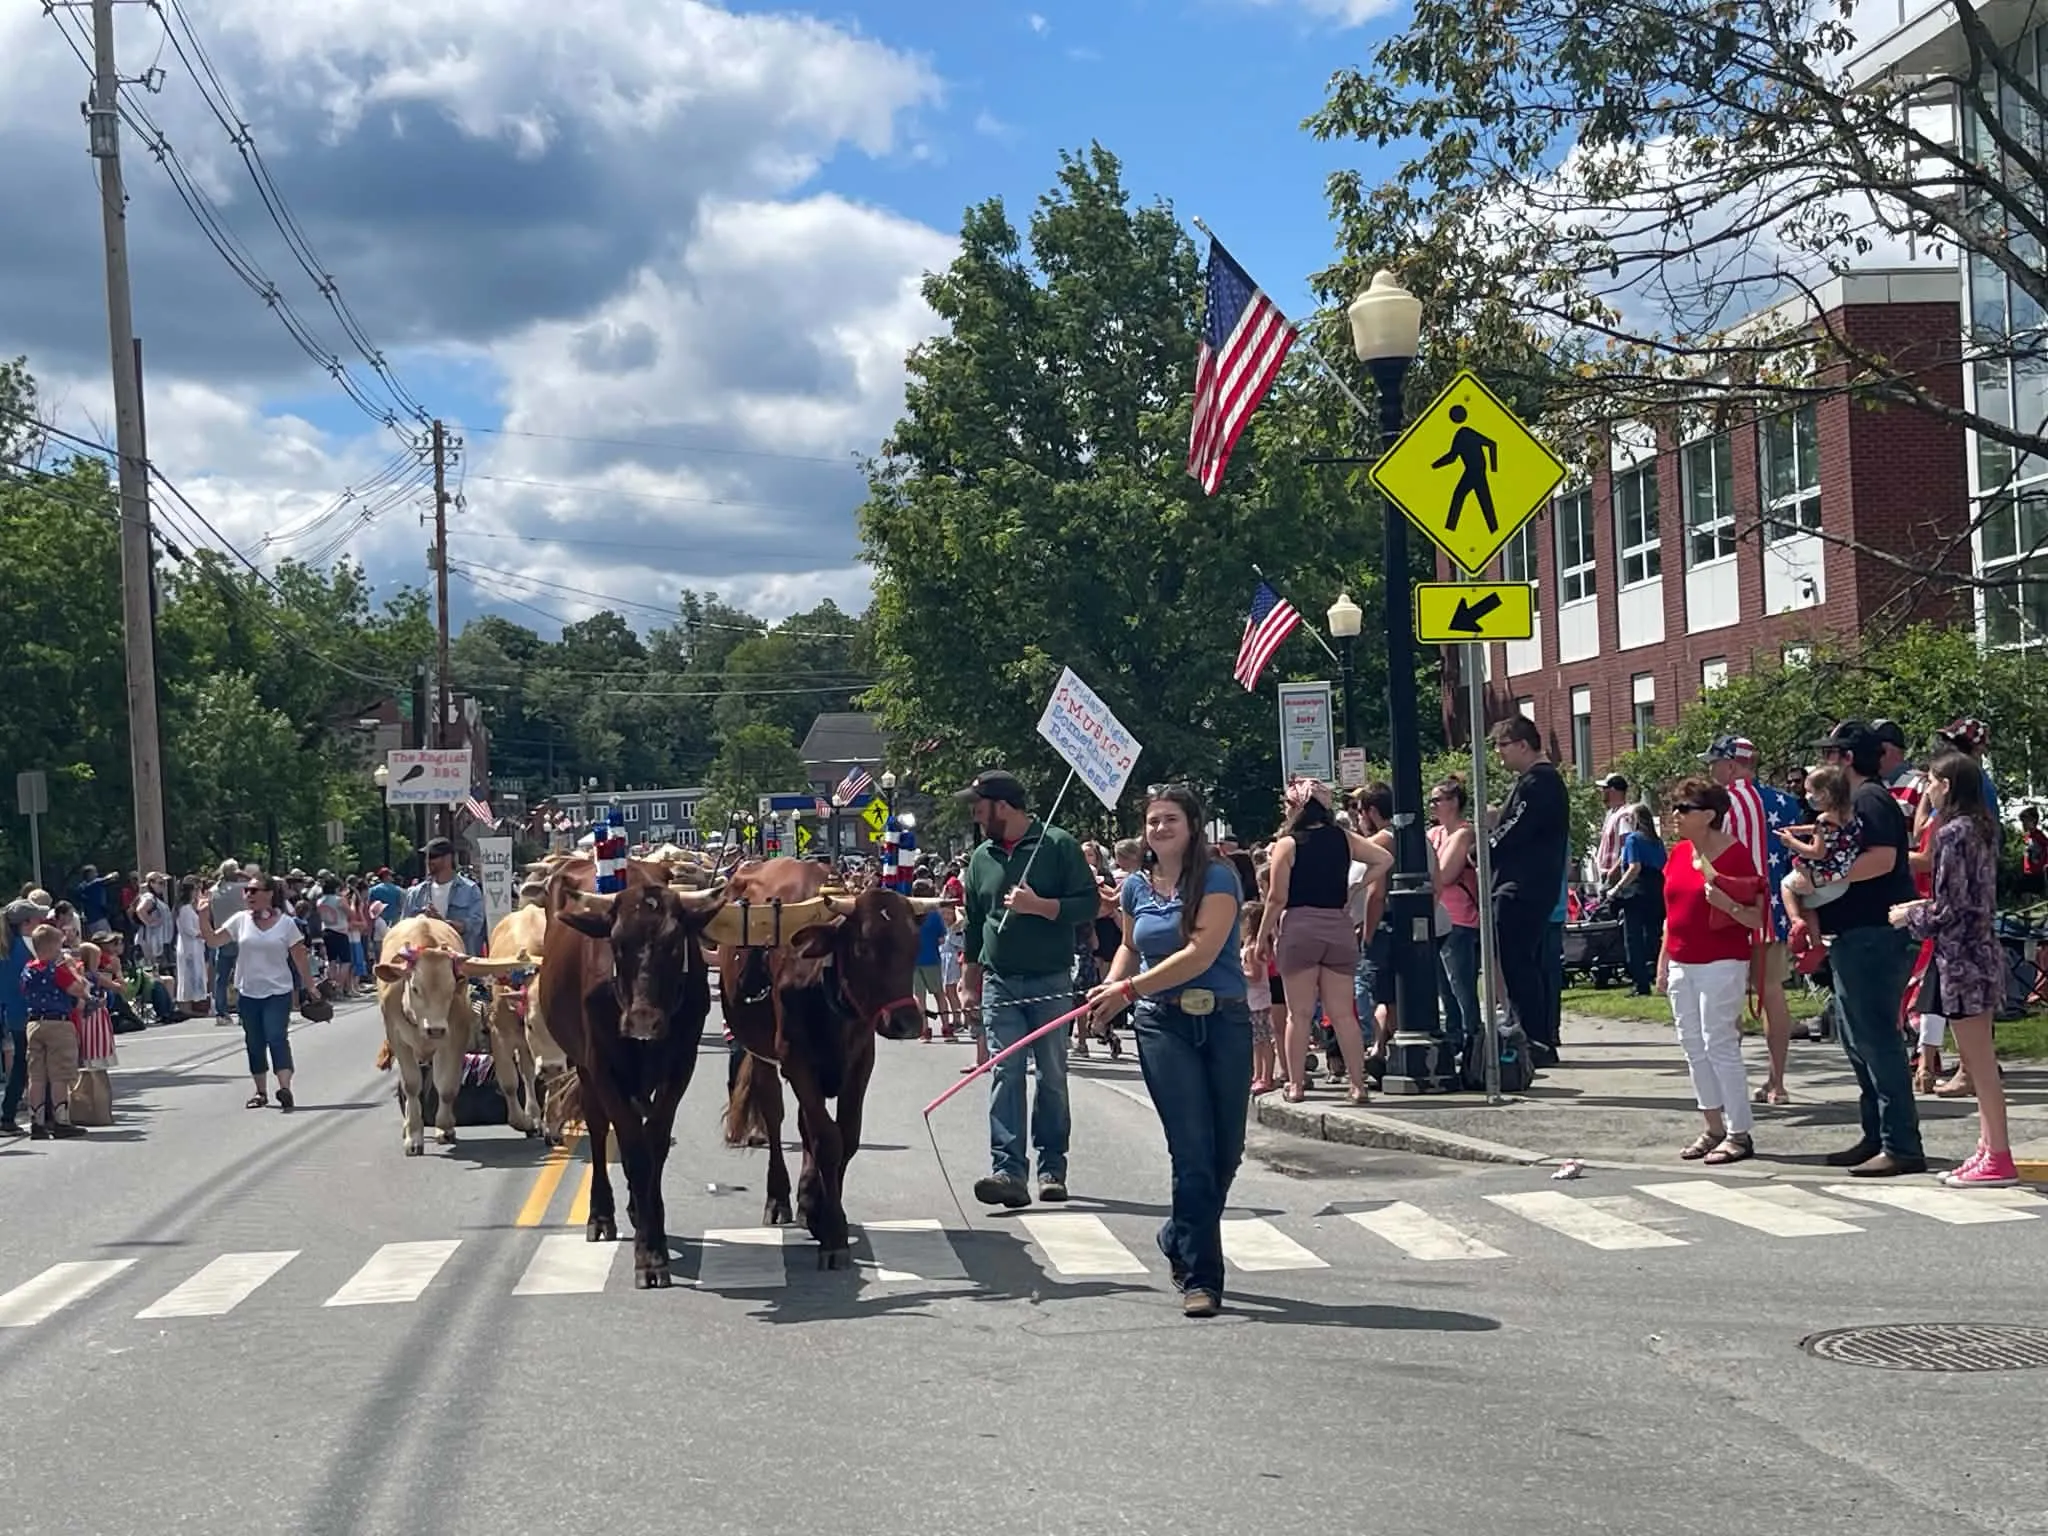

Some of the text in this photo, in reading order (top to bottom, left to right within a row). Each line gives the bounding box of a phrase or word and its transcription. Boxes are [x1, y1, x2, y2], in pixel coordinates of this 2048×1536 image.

[1052, 704, 1121, 787] Something
[1067, 697, 1120, 757] MUSIC
[392, 751, 468, 765] The English
[1049, 723, 1109, 792] Reckless
[391, 788, 430, 801] Every
